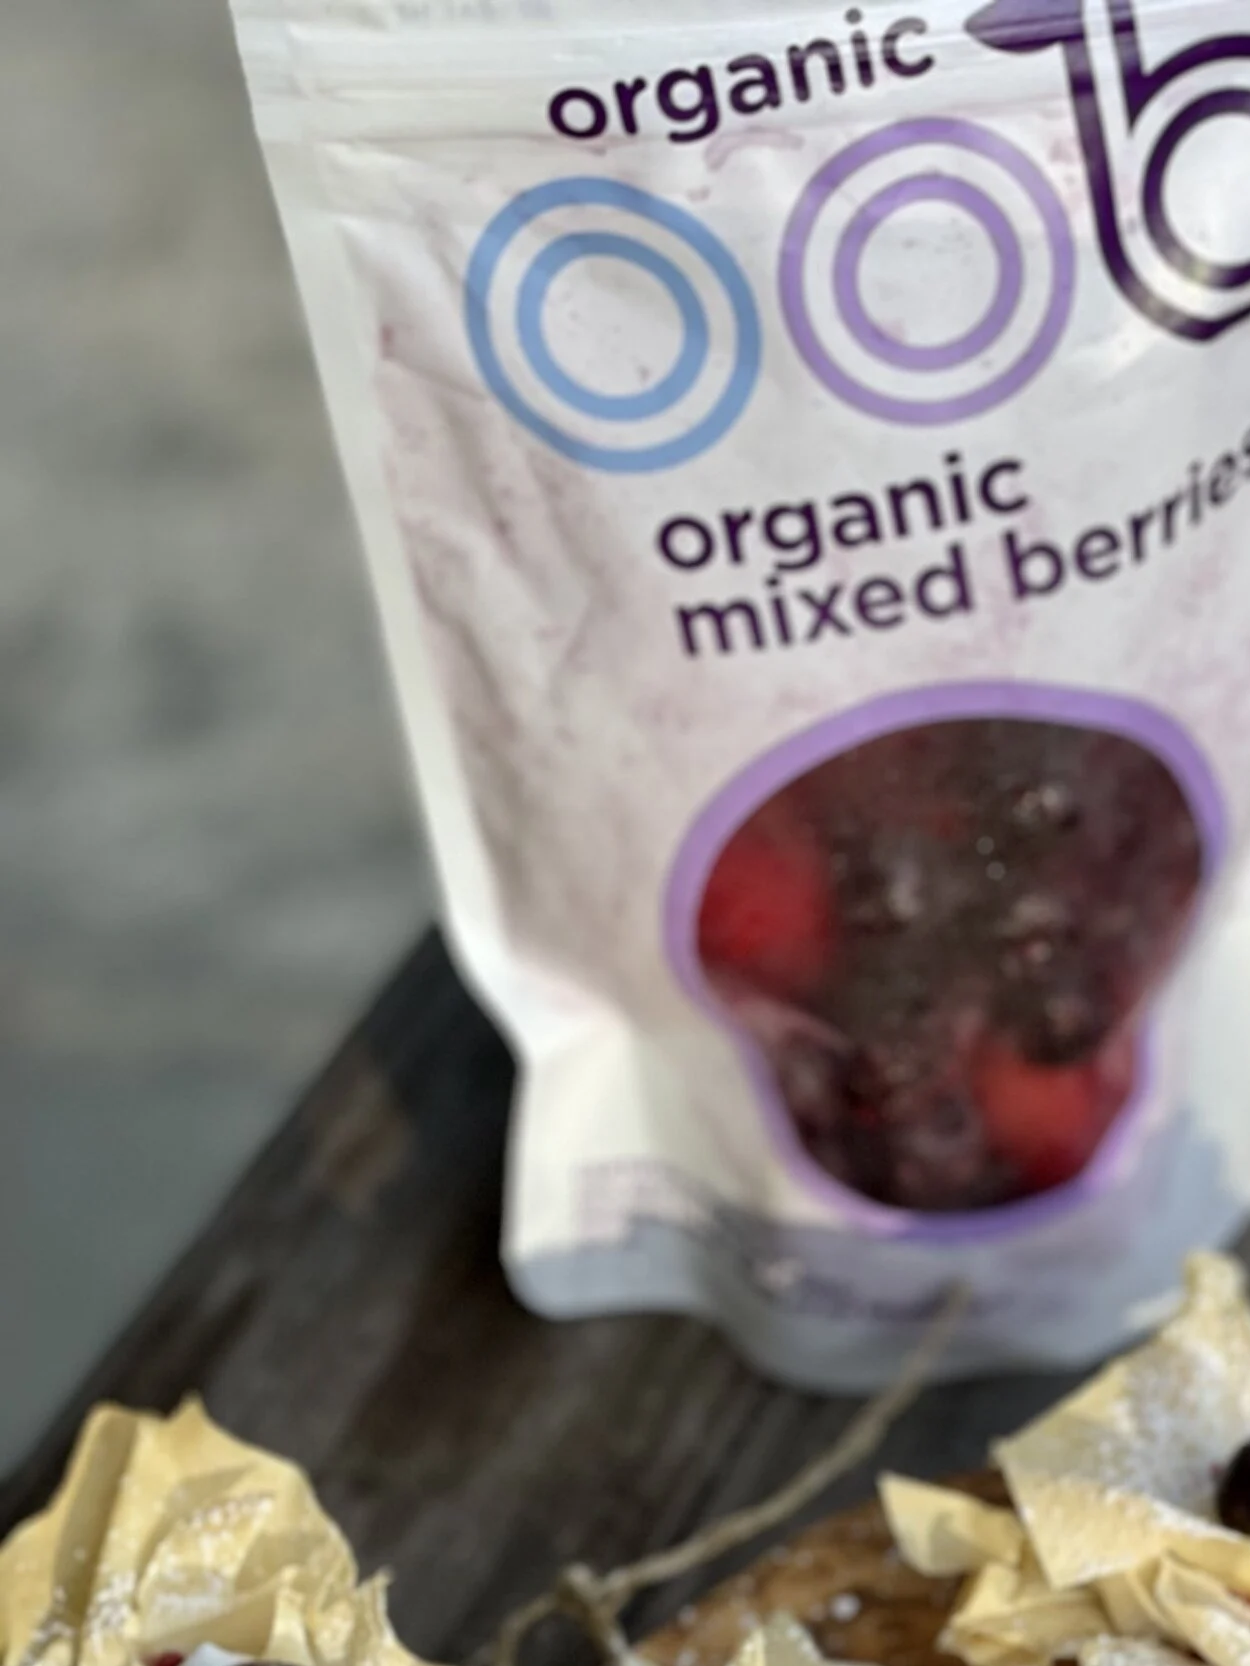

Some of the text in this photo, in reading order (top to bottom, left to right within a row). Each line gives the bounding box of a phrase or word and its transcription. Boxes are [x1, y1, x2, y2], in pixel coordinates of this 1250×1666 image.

[547, 9, 936, 143] organic
[656, 452, 1030, 572] organic
[675, 546, 974, 658] mixed
